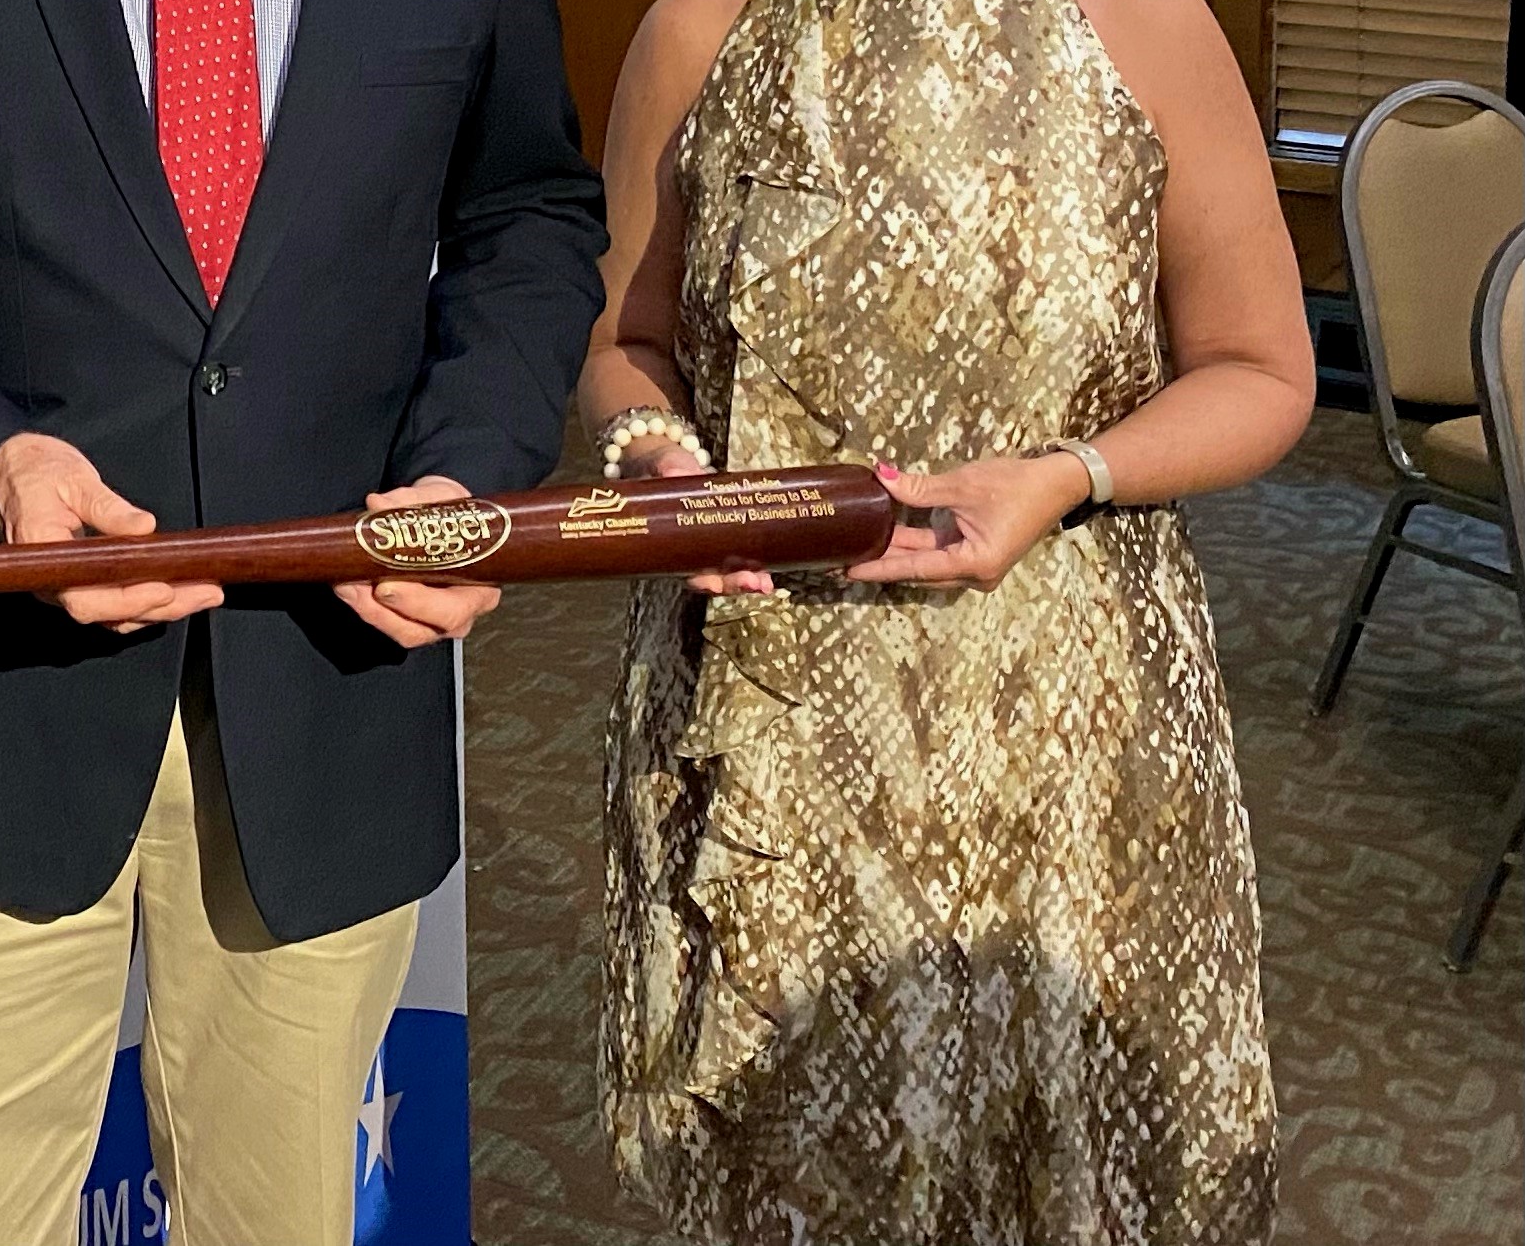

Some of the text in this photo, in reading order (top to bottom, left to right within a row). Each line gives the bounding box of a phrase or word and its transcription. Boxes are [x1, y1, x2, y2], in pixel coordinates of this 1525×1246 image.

[680, 488, 822, 510] Thank You for Going to Bat
[559, 517, 648, 532] Kentucky Chamber
[676, 512, 695, 526] For
[696, 509, 747, 524] Kentucky
[748, 506, 796, 521] Business
[370, 511, 497, 555] Slugger
